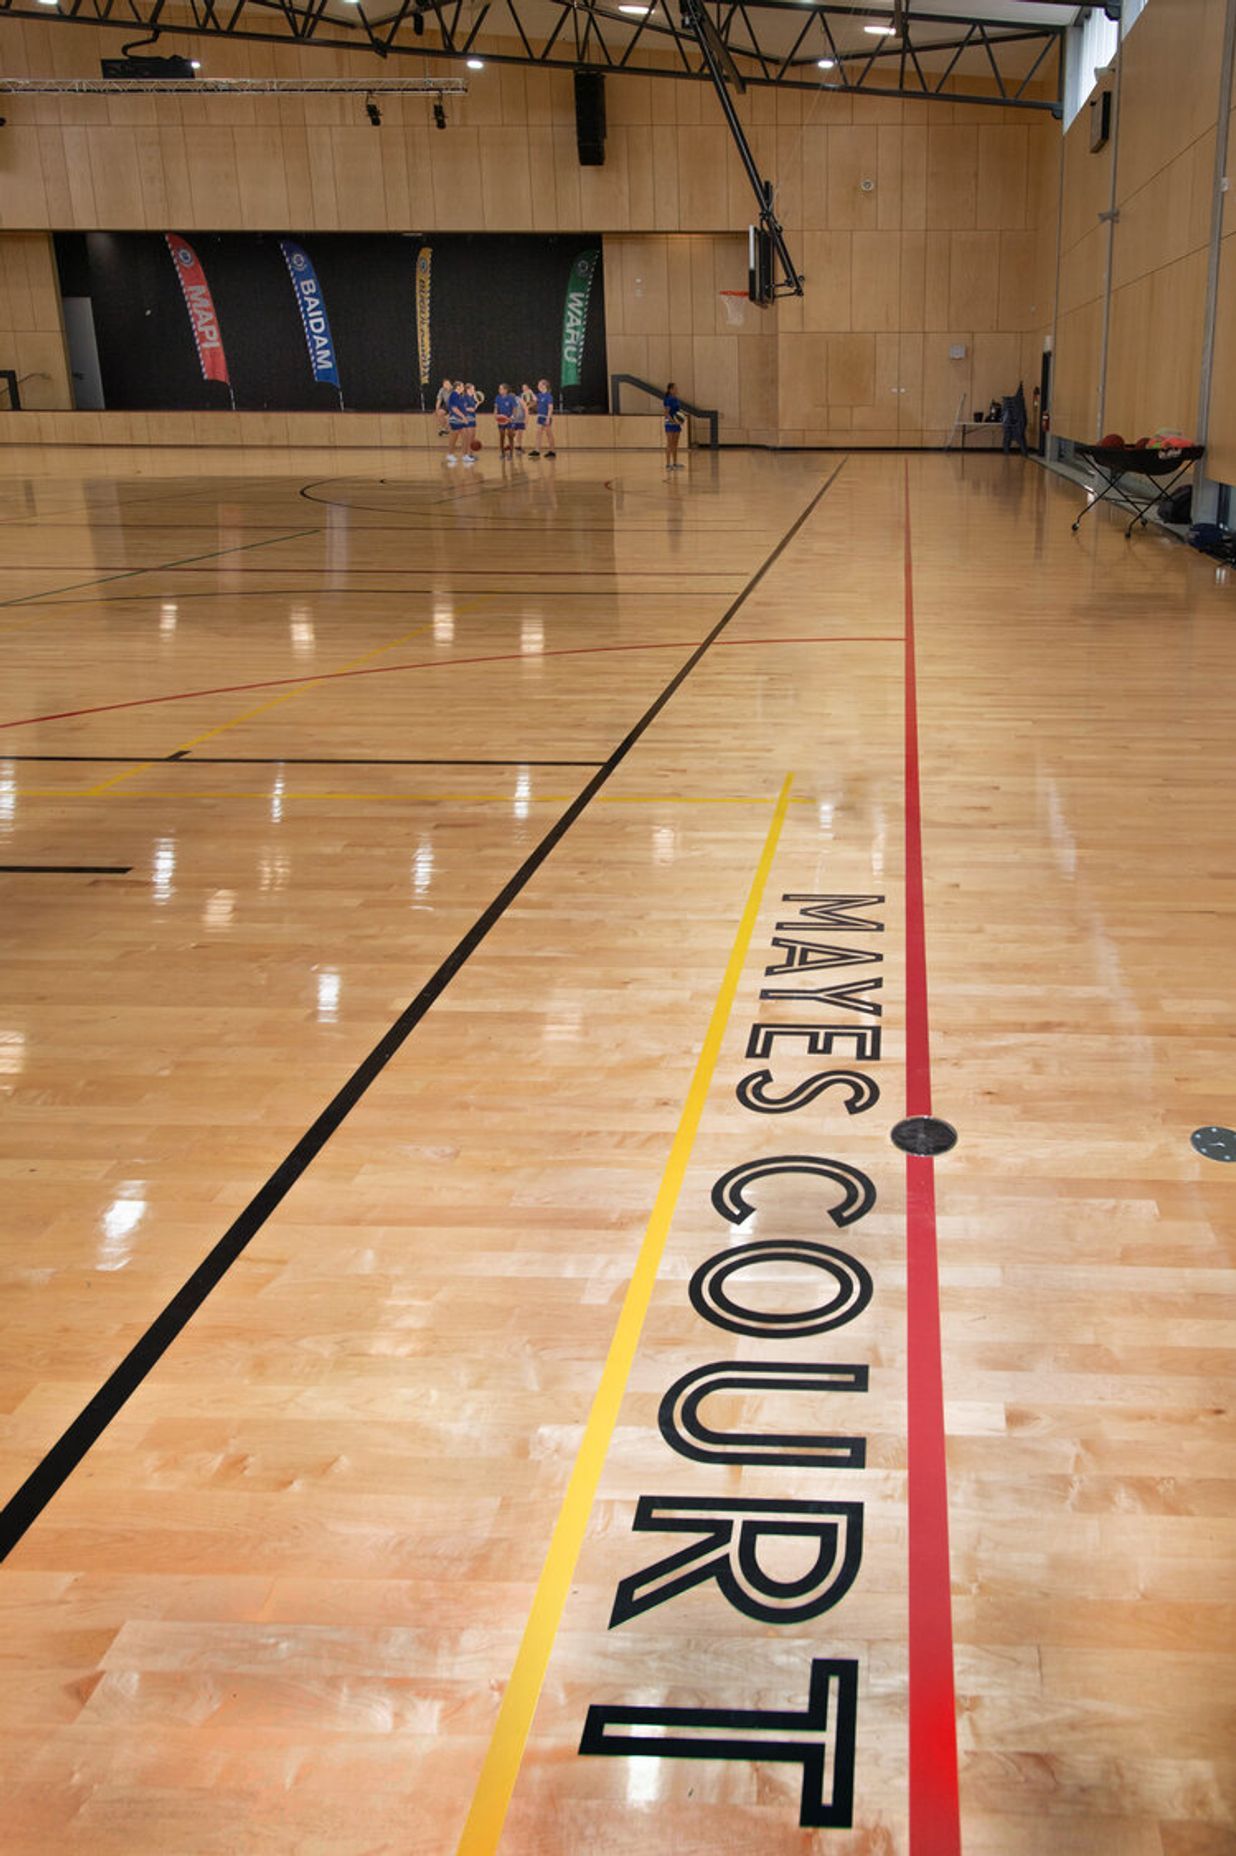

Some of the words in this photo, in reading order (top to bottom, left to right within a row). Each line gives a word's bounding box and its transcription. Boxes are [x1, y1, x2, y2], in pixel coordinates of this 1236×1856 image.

[187, 284, 221, 349] MAPI
[299, 279, 334, 370] BAIDAM
[563, 291, 585, 363] WARU
[735, 893, 886, 1115] MAYES
[577, 1154, 877, 1829] COURT
